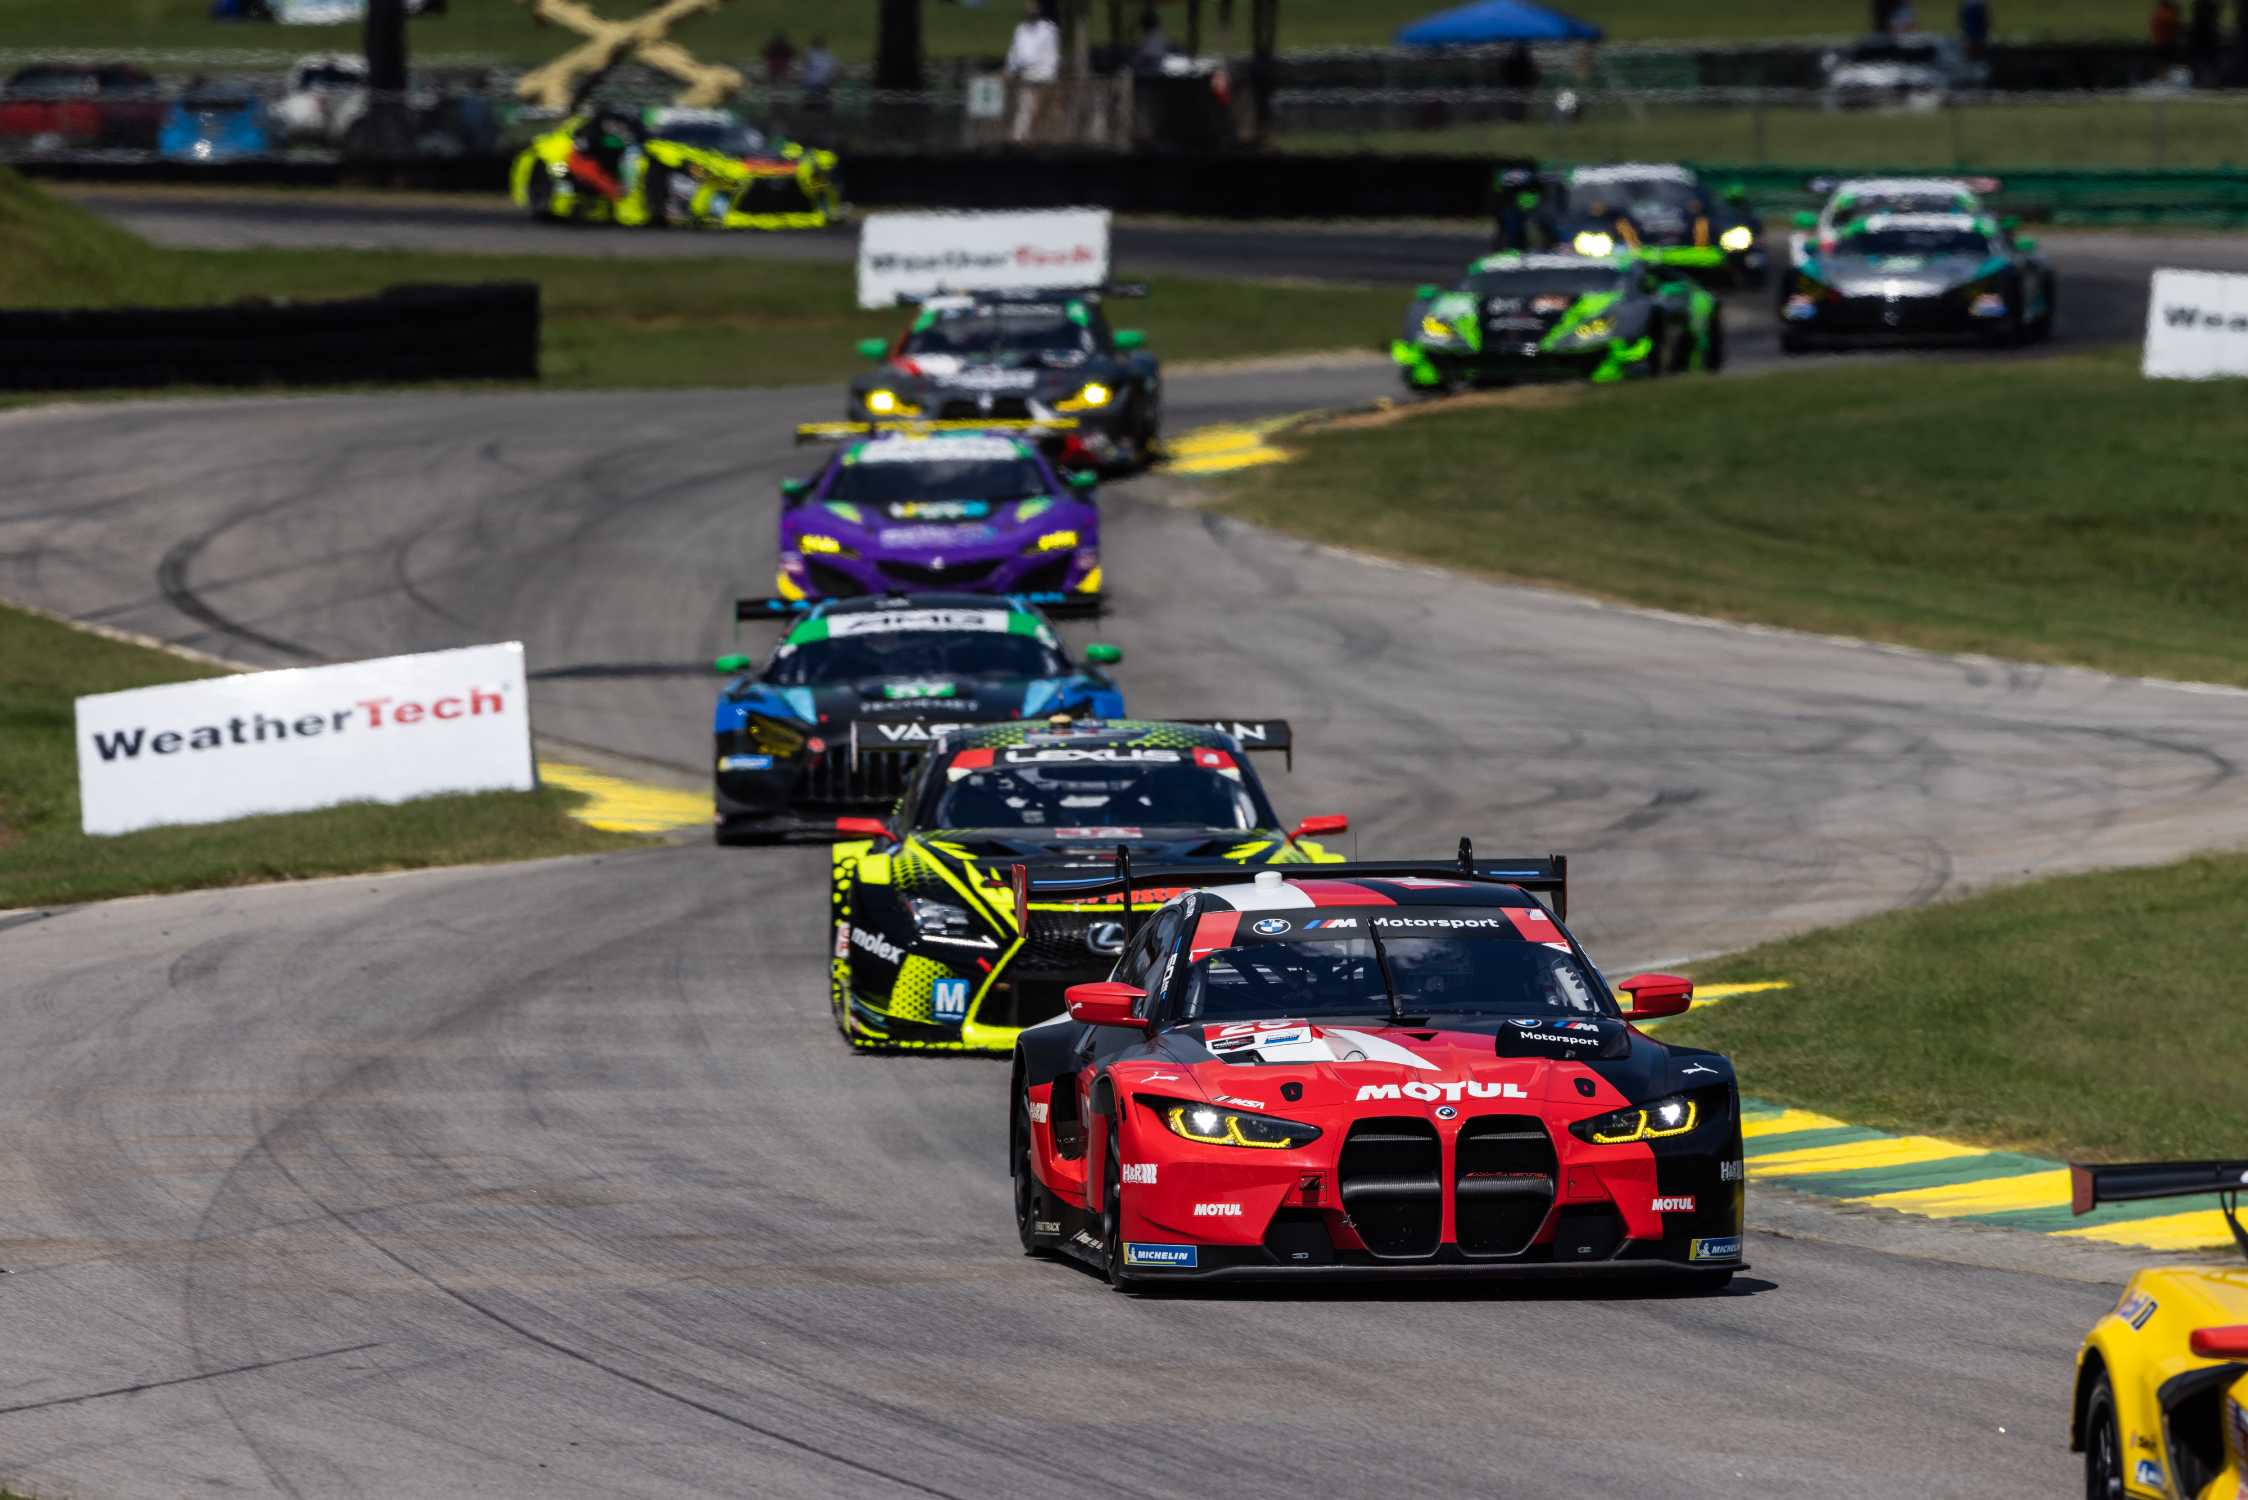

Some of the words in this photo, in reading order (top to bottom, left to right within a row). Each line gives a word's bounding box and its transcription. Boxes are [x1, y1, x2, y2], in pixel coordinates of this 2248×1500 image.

[94, 686, 506, 761] WeatherTech
[1005, 749, 1182, 764] LEXUS
[1367, 917, 1500, 929] Motorsport
[851, 927, 906, 965] molex
[935, 982, 966, 1013] M
[1520, 1031, 1600, 1047] Motorsport
[1355, 1080, 1529, 1102] MOTUL
[1193, 1203, 1243, 1216] MOTUL
[1651, 1198, 1695, 1211] MOTUL
[1137, 1250, 1189, 1261] MICHELIN
